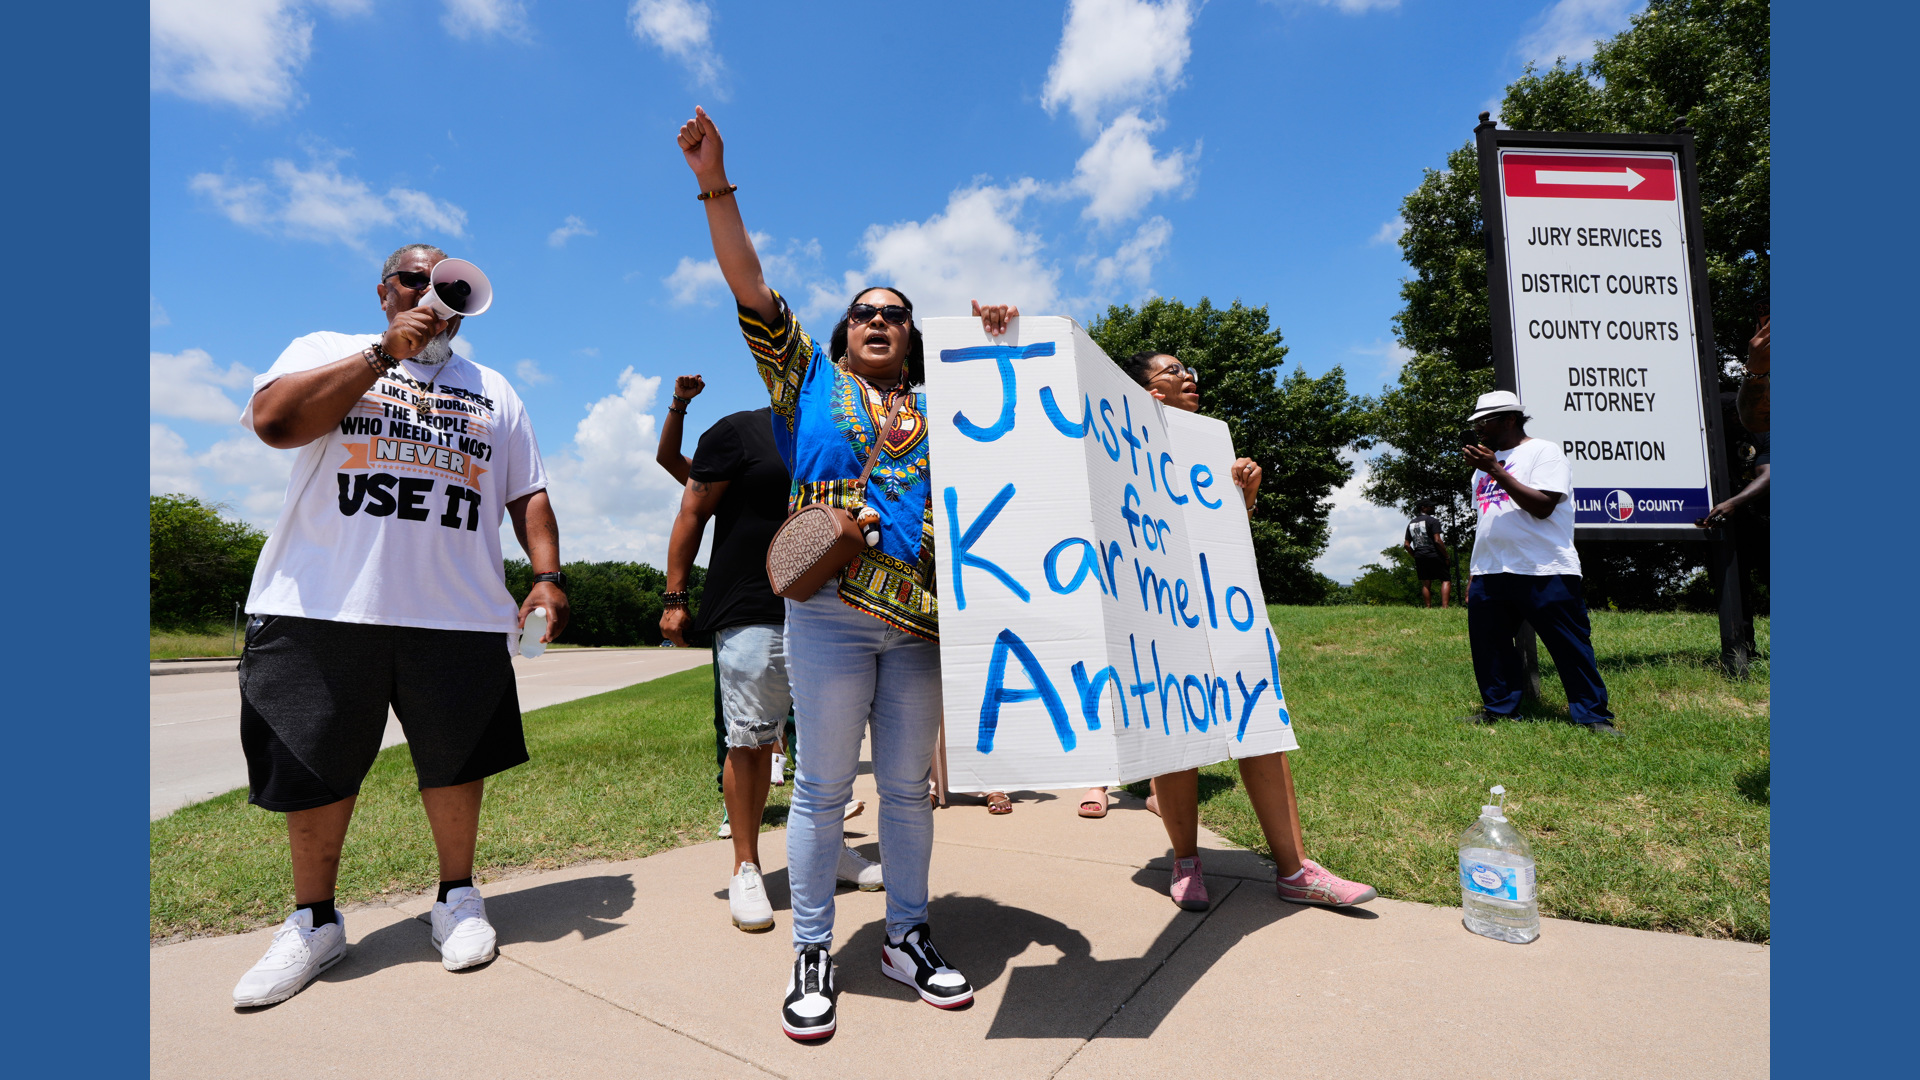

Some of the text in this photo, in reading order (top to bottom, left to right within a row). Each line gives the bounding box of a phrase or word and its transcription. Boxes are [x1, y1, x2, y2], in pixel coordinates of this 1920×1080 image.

[1528, 227, 1662, 248] JURY SERVICES
[1522, 273, 1678, 295] DISTRICT COURTS
[1529, 319, 1679, 341] COUNTY COURTS
[1568, 367, 1648, 387] DISTRICT
[381, 383, 483, 416] LIKE DODORANT
[438, 384, 495, 412] SENSE
[1564, 392, 1656, 412] ATTORNEY
[340, 416, 382, 436] WHO
[389, 420, 432, 443] NEED
[438, 432, 454, 448] IT
[382, 402, 470, 434] THE PEOPLE
[940, 341, 1222, 510] Justice
[376, 439, 465, 475] NEVER
[1563, 440, 1665, 461] PROBATION
[337, 472, 482, 532] USE IT
[1573, 500, 1602, 512] LLIN
[1638, 499, 1684, 512] COUNTY
[1121, 483, 1171, 555] for
[944, 483, 1255, 632] Karmelo
[977, 628, 1290, 755] Anthony!
